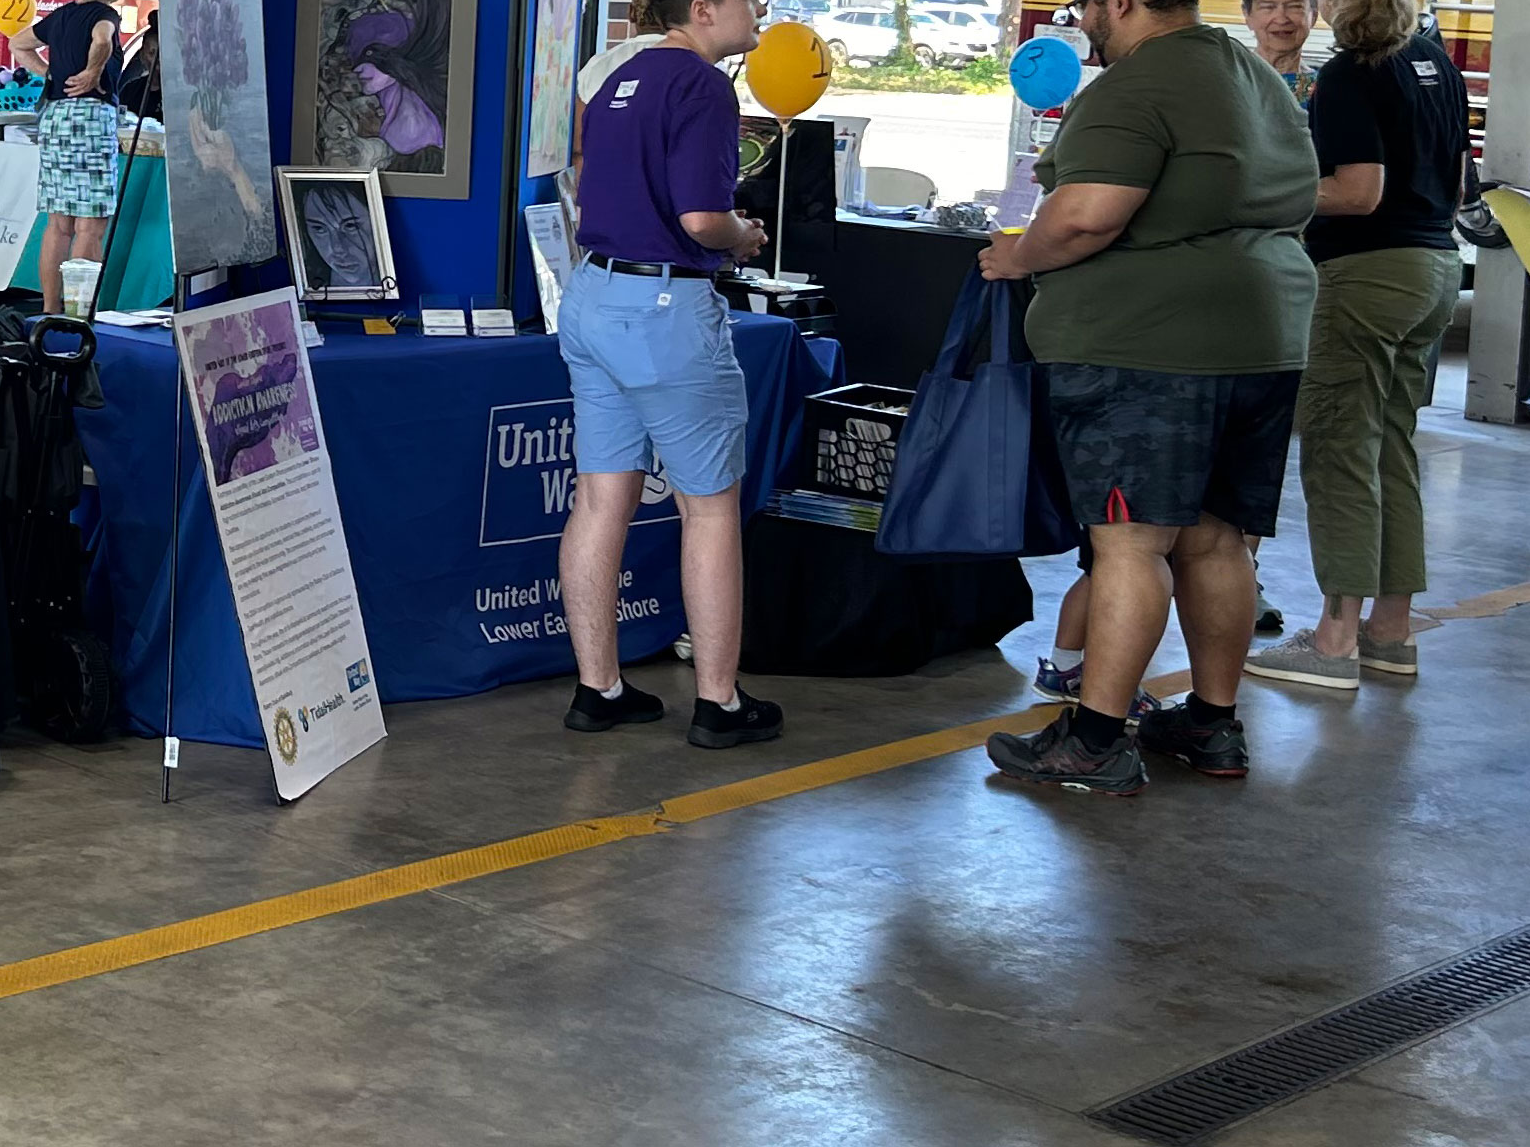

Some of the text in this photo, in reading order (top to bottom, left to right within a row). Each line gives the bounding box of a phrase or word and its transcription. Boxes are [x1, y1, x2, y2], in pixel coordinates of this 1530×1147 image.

[497, 417, 575, 469] Unit
[476, 580, 540, 612] United
[480, 619, 540, 644] Lower
